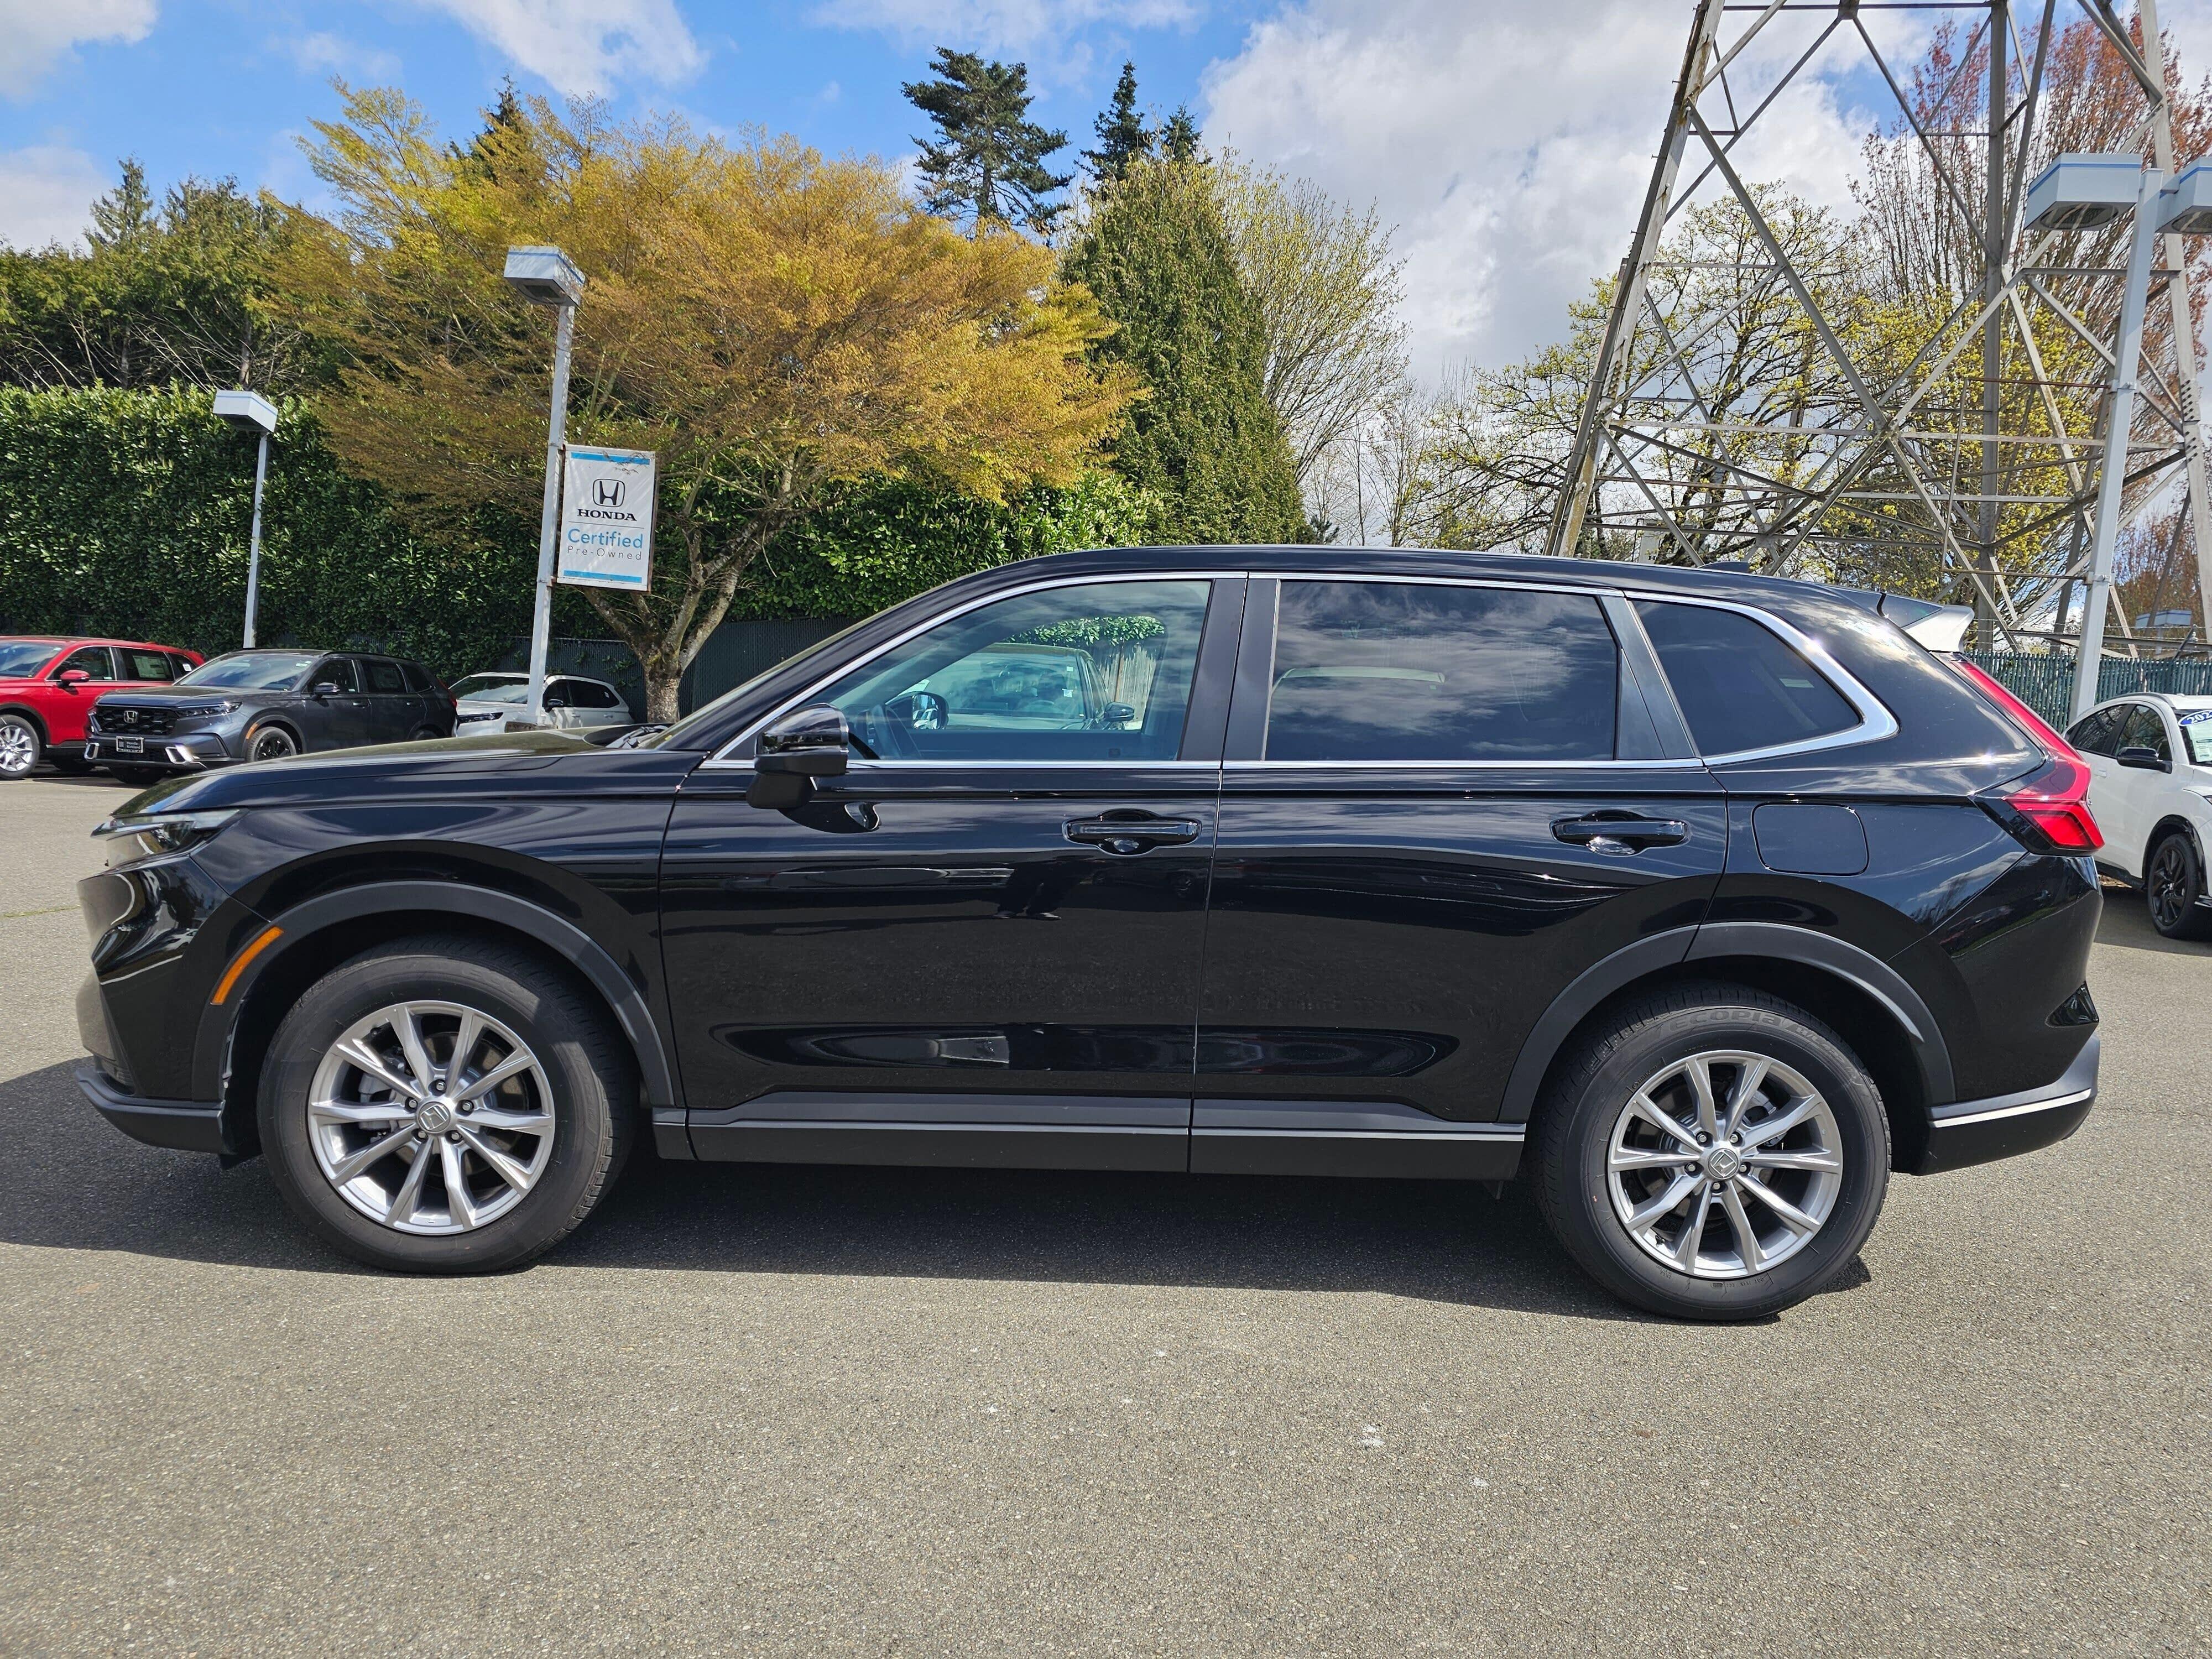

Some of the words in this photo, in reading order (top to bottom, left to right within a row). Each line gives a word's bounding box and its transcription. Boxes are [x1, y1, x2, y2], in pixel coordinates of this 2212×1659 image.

[577, 509, 637, 521] HONDA
[568, 528, 643, 548] Certified
[567, 545, 641, 560] Pre-Owned
